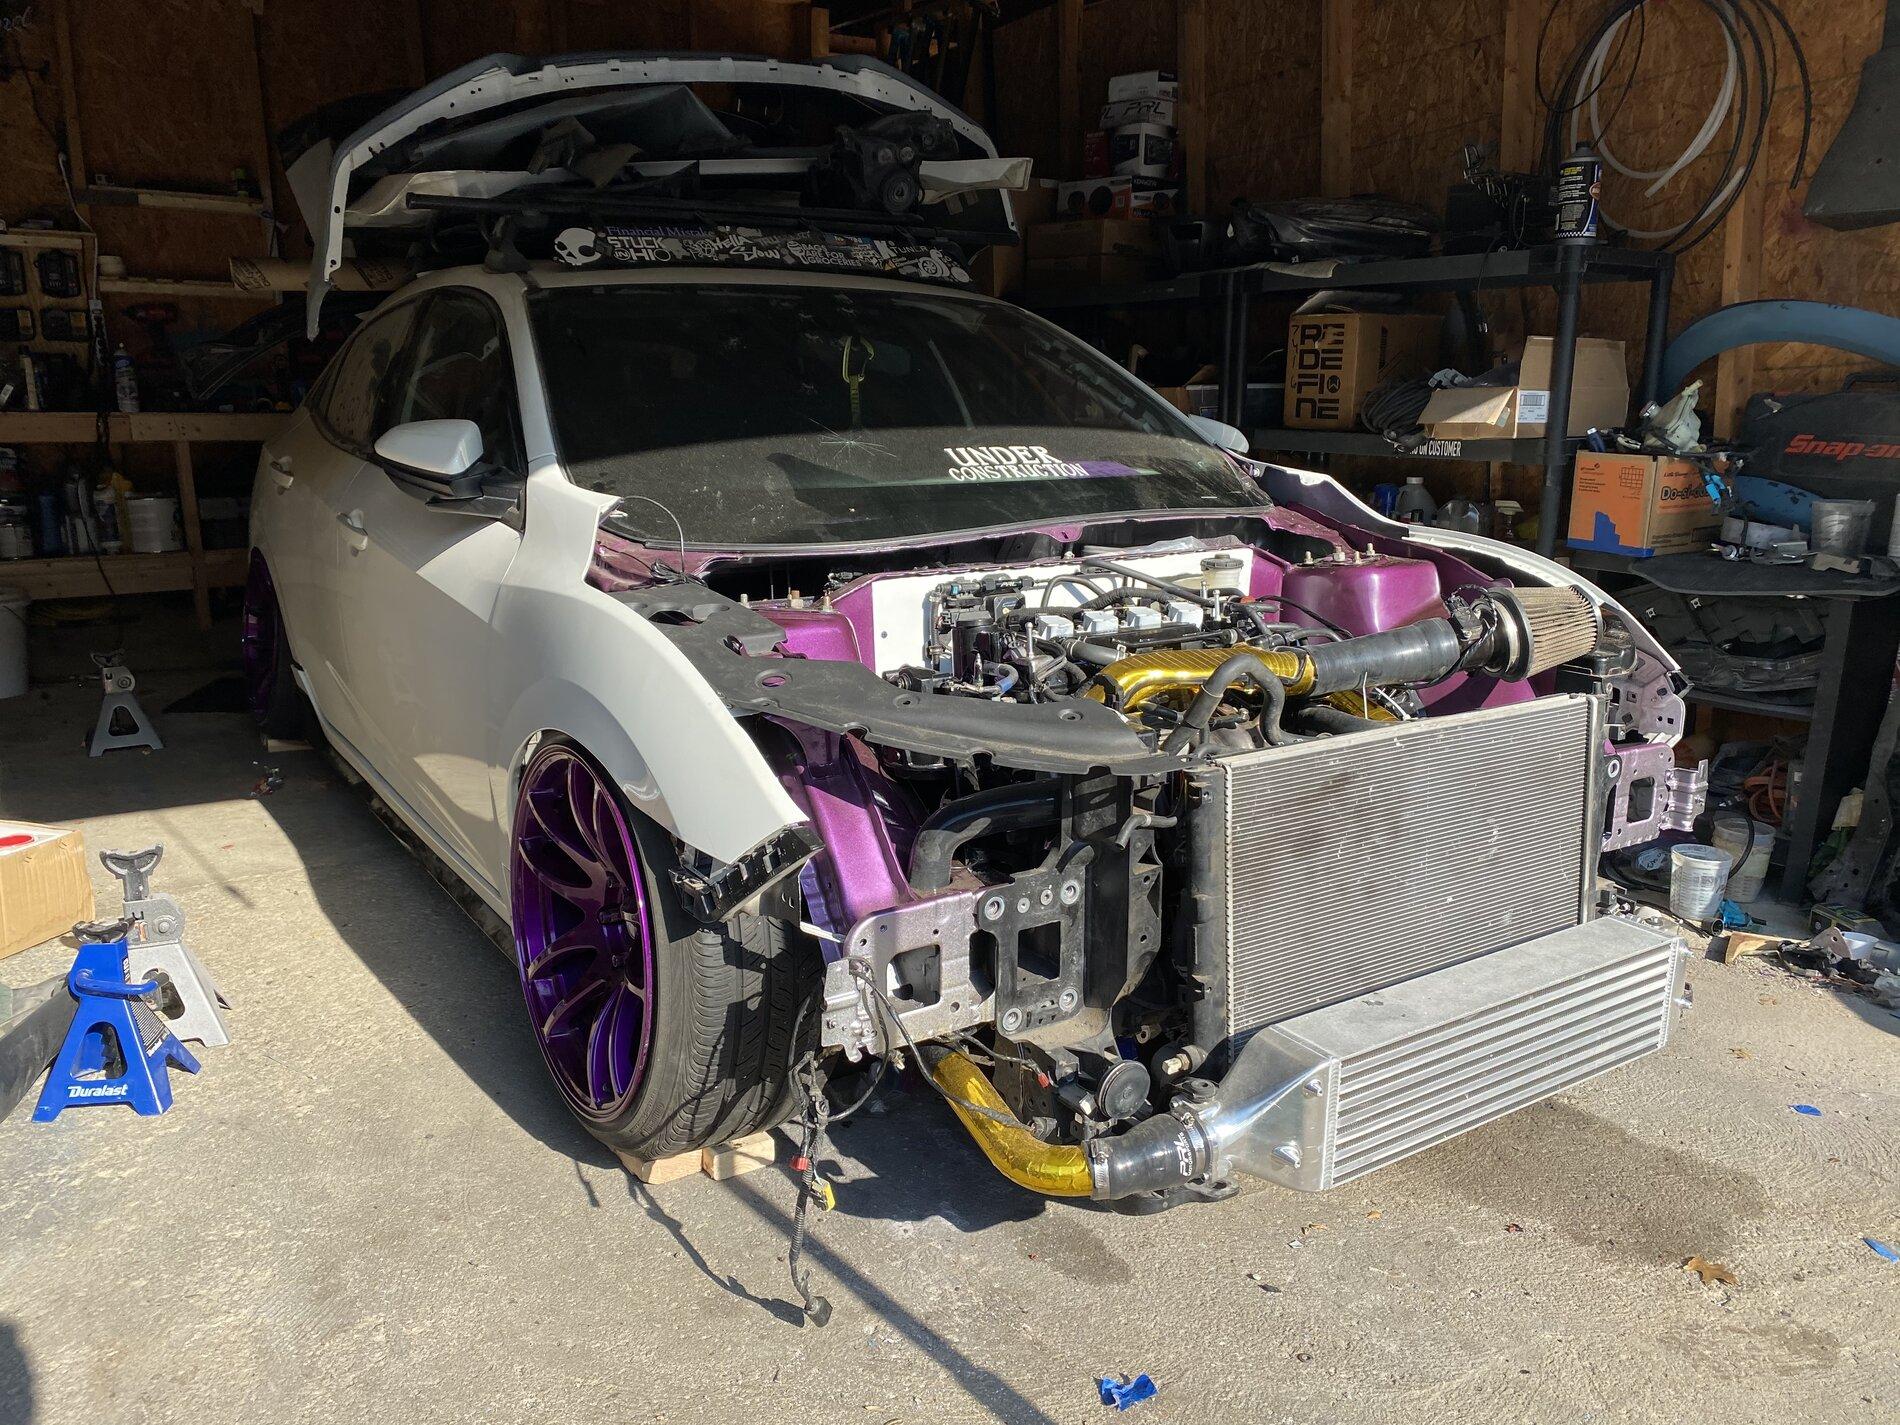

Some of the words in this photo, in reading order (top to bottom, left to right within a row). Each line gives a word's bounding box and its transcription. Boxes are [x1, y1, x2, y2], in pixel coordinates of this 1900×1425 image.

[607, 226, 663, 237] Financial
[607, 236, 664, 249] STUCK
[807, 256, 862, 267] GROCERIES
[944, 445, 1062, 467] UNDER
[1428, 441, 1462, 457] CUSTOMER
[949, 462, 1090, 481] CONSTRUCTION
[67, 1083, 128, 1098] Duralast
